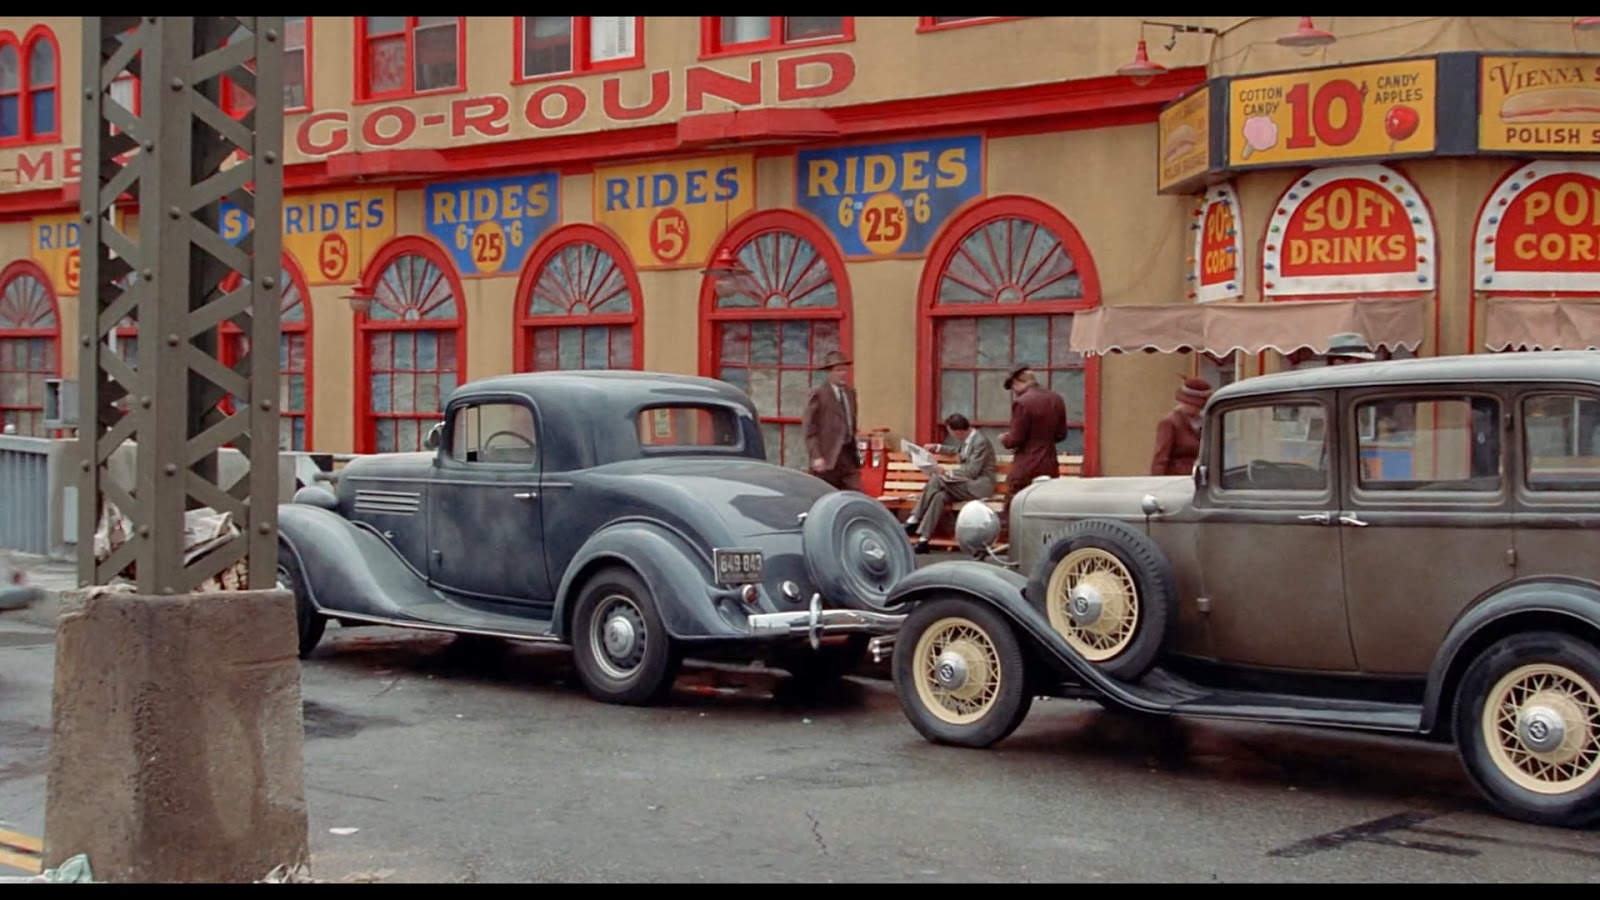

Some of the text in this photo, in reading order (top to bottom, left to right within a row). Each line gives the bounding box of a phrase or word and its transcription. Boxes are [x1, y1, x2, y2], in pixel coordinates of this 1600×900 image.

[1376, 73, 1419, 89] CANDY
[1489, 62, 1584, 95] VIENNA
[295, 51, 856, 156] GO-ROUND
[1239, 87, 1283, 103] COTTON
[1243, 101, 1280, 116] CANDY
[1374, 88, 1424, 104] APPLES
[1505, 127, 1581, 144] POLISH
[806, 147, 968, 197] RIDES
[433, 183, 549, 225] RIDES
[606, 166, 739, 211] RIDES
[285, 198, 385, 235] RIDES
[838, 196, 854, 227] 6
[913, 191, 931, 223] 6
[1303, 186, 1395, 232] SOFT
[38, 222, 81, 250] RID
[455, 223, 468, 250] 6
[510, 219, 523, 248] 6
[1289, 234, 1408, 265] DRINKS
[1514, 233, 1600, 261] COR
